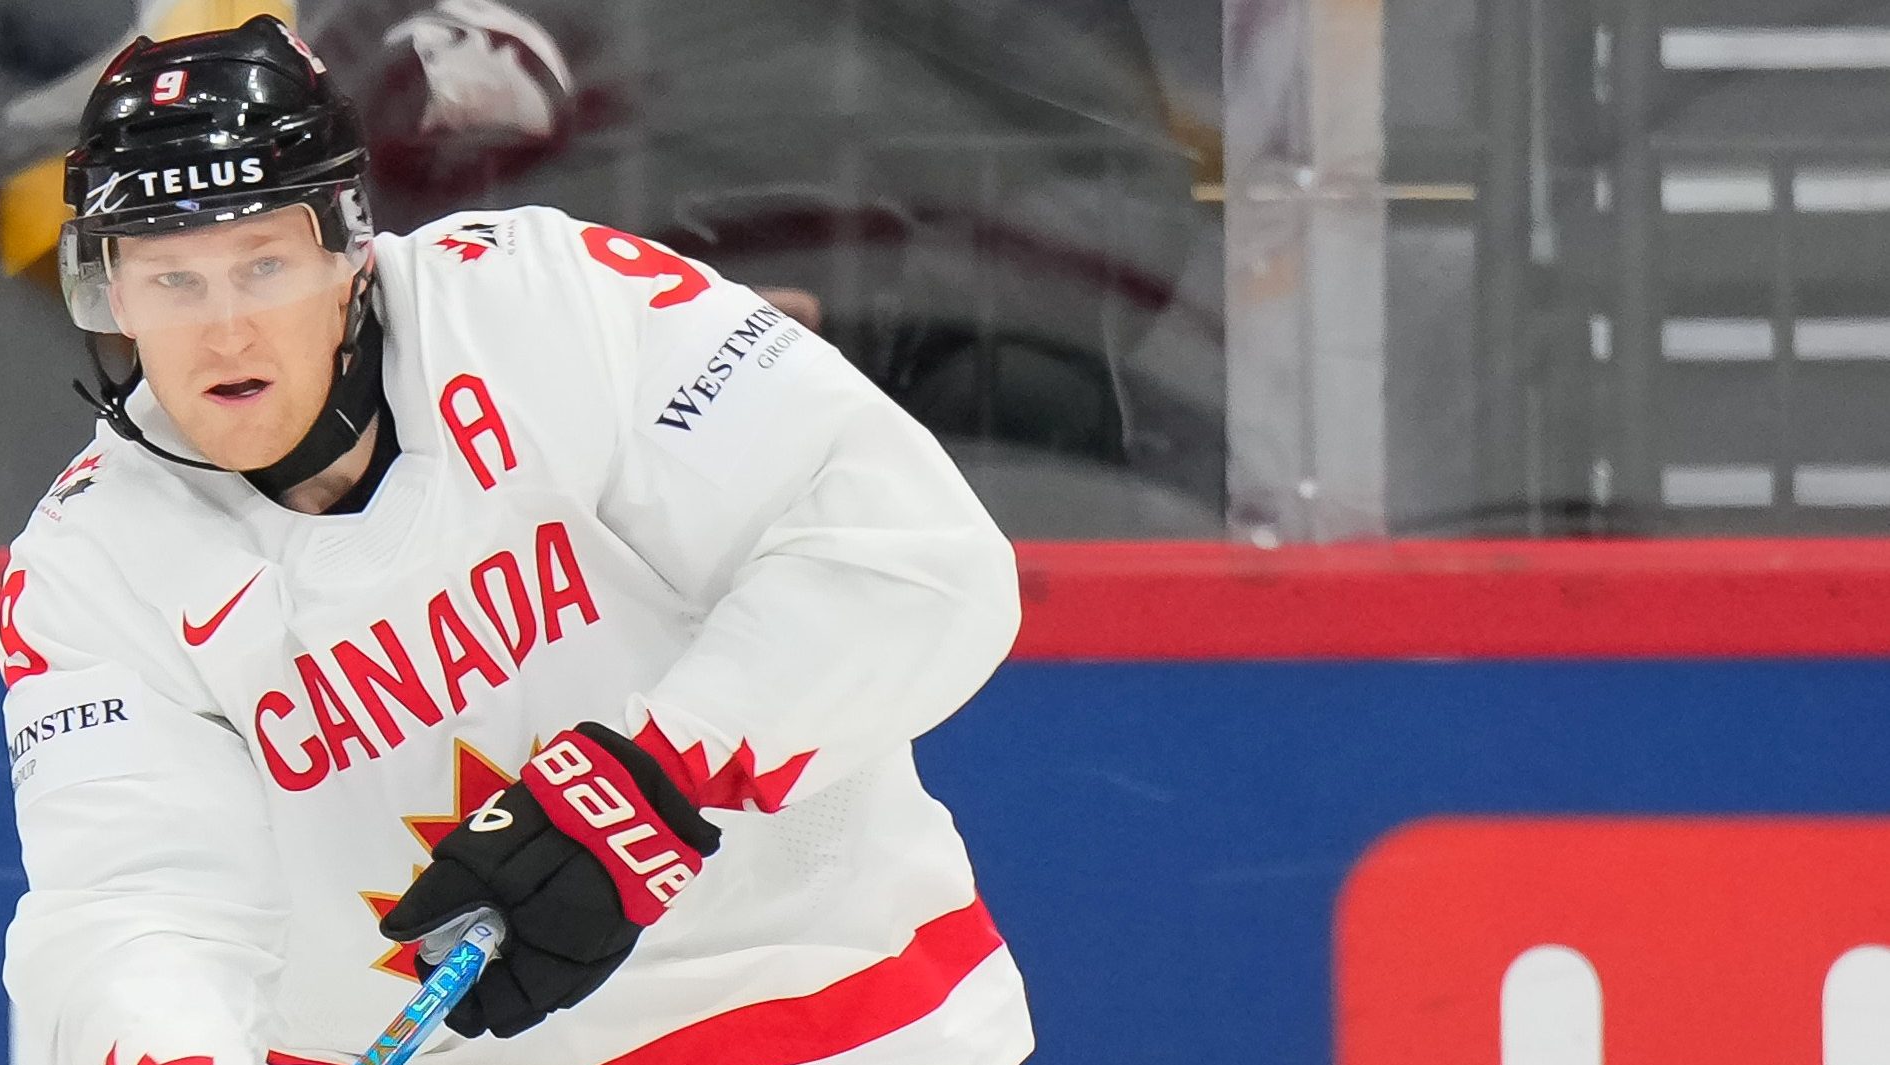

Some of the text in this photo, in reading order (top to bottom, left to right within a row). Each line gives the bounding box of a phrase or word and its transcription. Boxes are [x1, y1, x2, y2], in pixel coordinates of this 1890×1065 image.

[152, 69, 189, 106] 9
[138, 157, 264, 197] TELUS
[580, 225, 711, 310] 9
[654, 304, 788, 432] WESTMIN
[439, 372, 517, 490] A
[255, 521, 600, 792] CANADA
